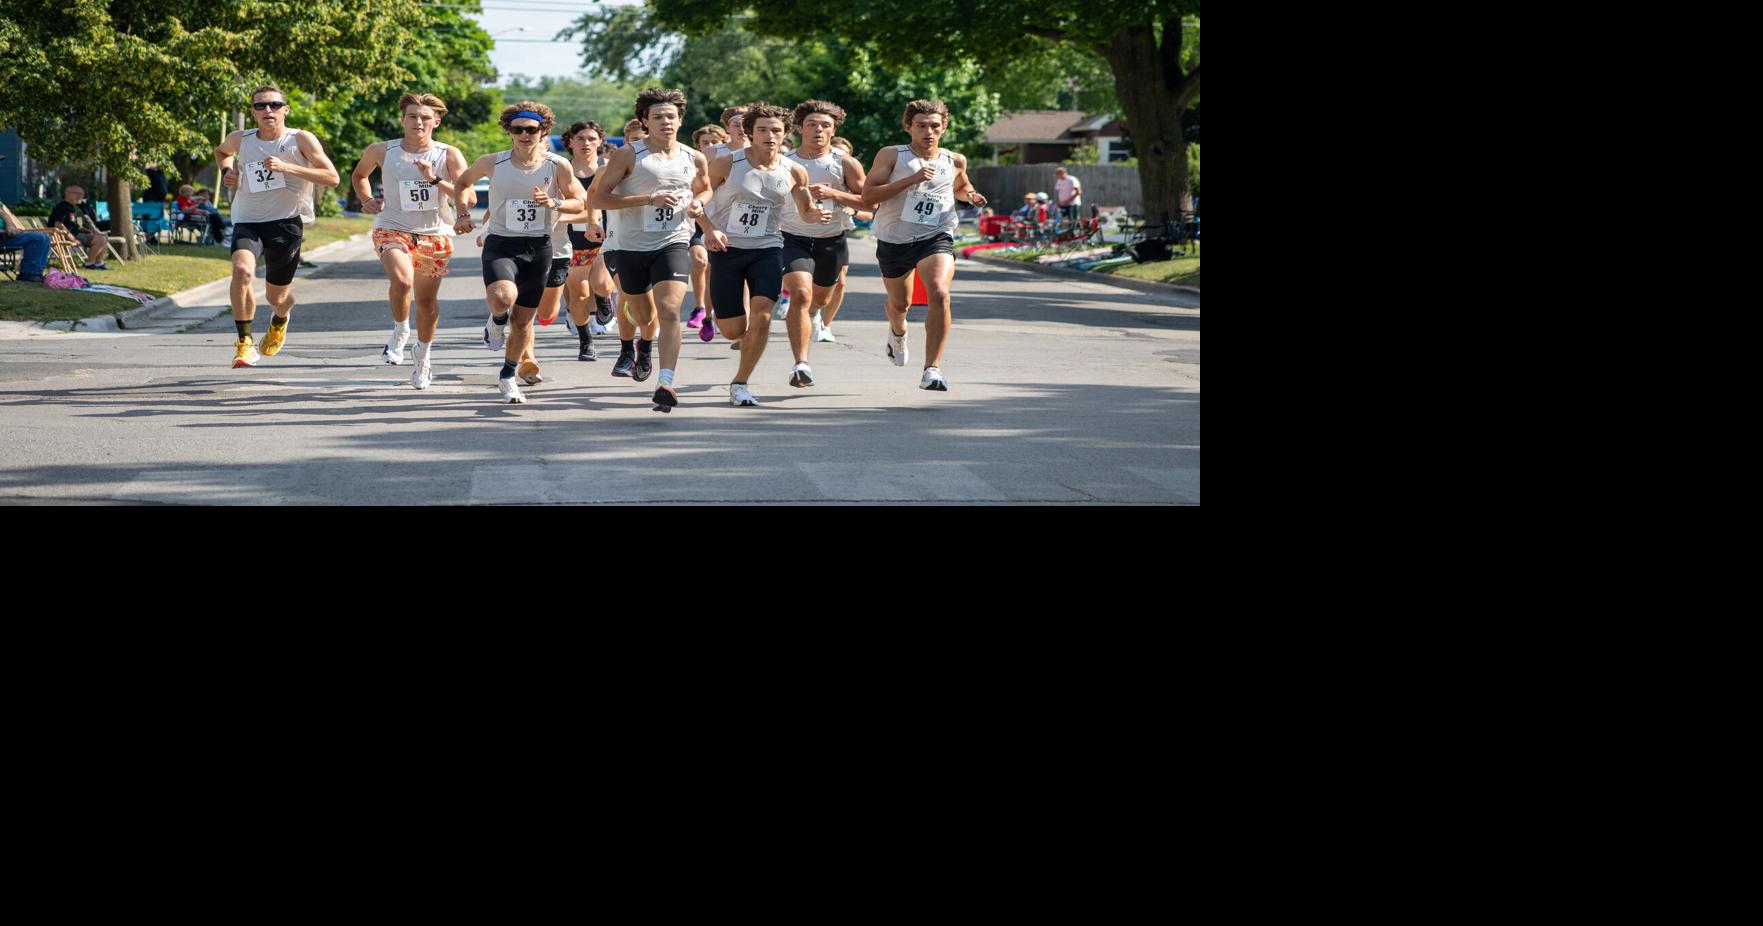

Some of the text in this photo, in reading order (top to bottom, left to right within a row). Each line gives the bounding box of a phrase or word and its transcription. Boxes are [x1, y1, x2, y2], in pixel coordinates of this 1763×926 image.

[255, 170, 275, 182] 32
[410, 189, 429, 201] 50
[914, 201, 934, 215] 49
[517, 209, 536, 221] 33
[655, 208, 674, 221] 39
[739, 213, 759, 226] 48
